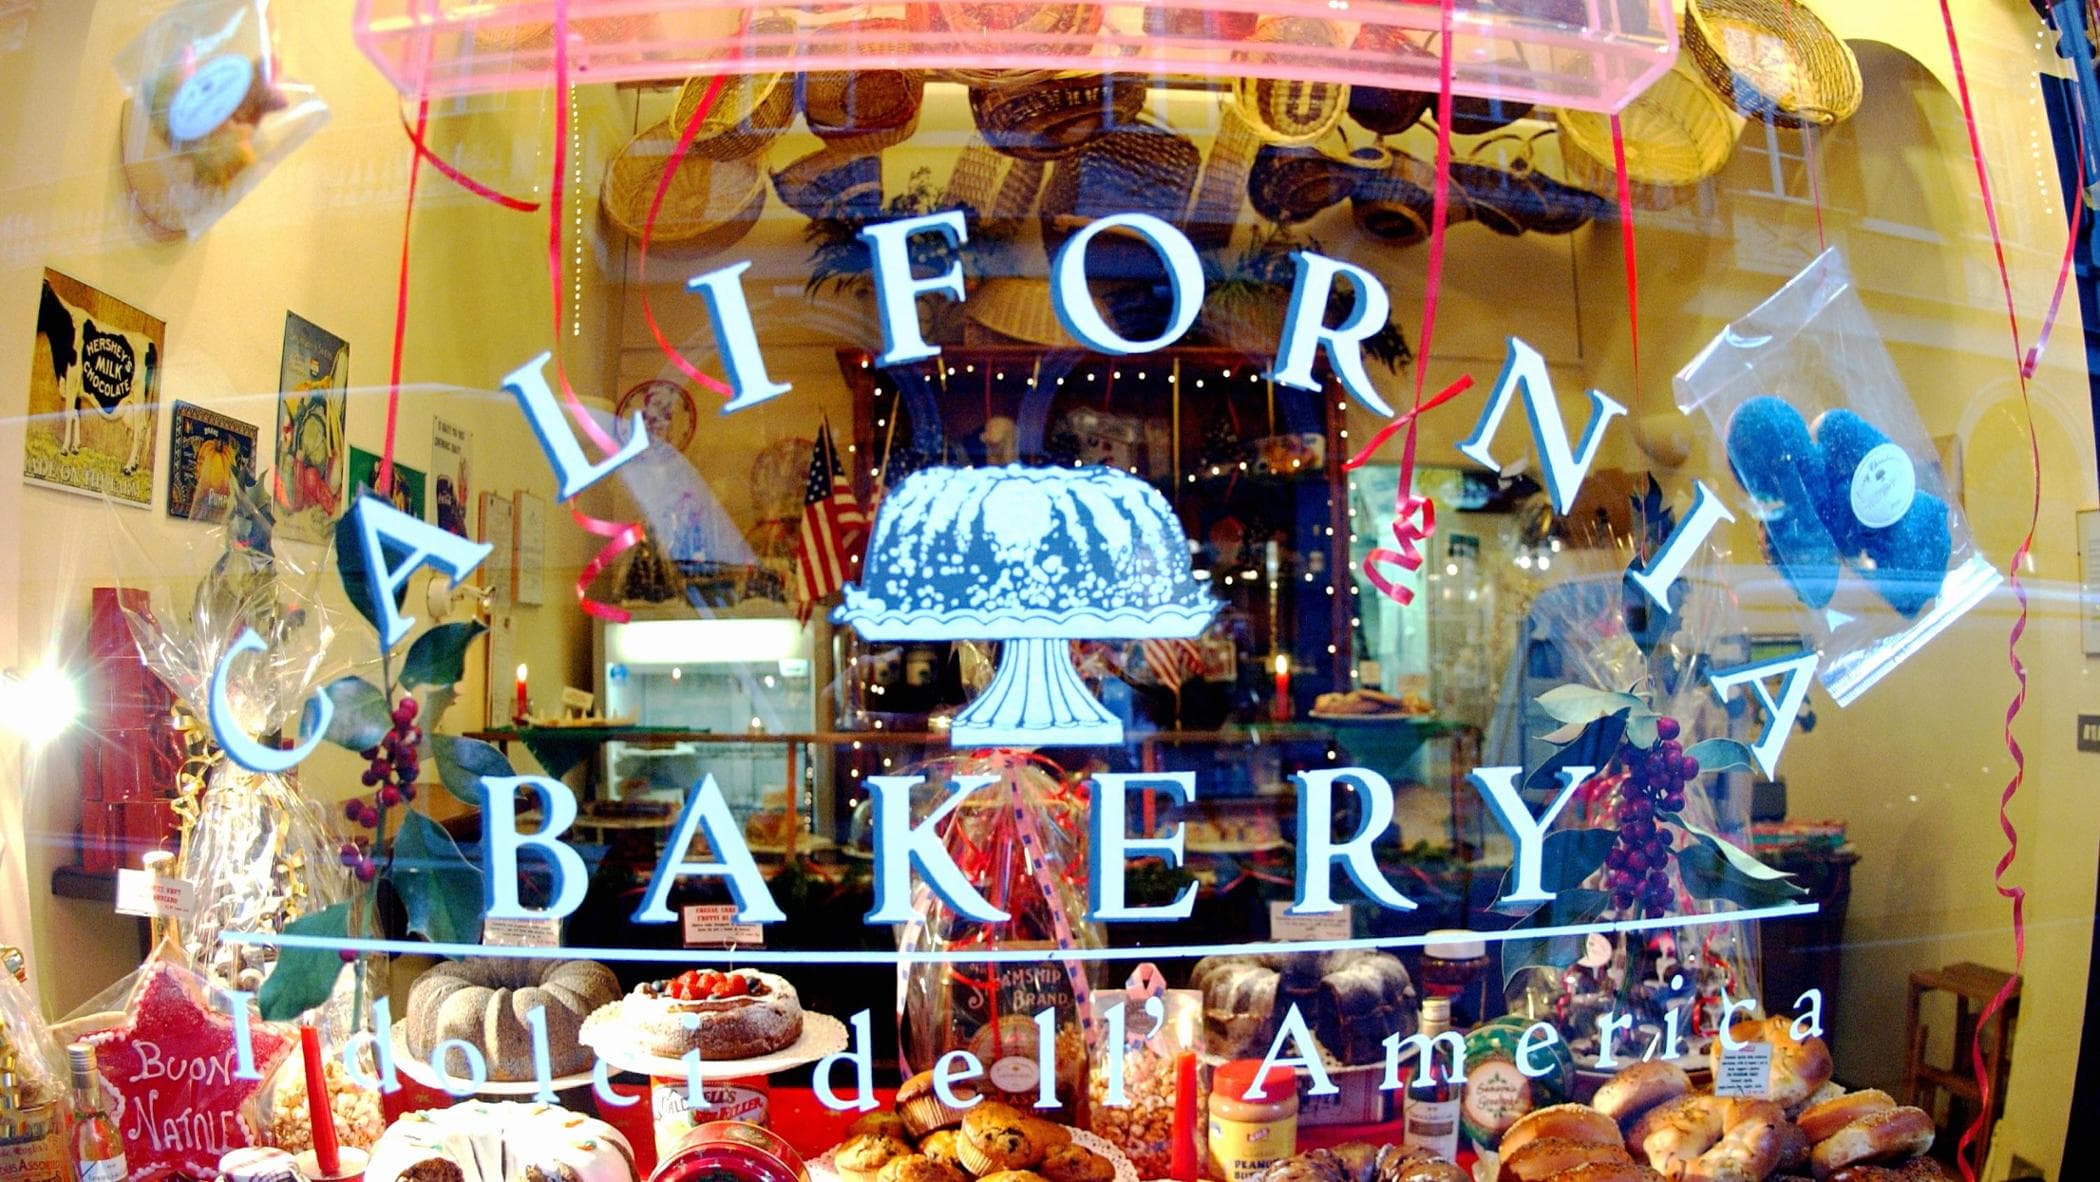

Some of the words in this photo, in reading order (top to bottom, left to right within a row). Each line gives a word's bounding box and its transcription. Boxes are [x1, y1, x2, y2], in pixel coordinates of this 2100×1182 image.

[87, 337, 133, 373] HERSHEY'S
[95, 356, 122, 380] MILK
[83, 361, 130, 397] CHOCOLATE
[209, 210, 1819, 782] CALIFORNIA
[479, 766, 1595, 925] BAKERY
[1013, 990, 1069, 1011] BRAND
[231, 990, 265, 1080] I
[343, 997, 711, 1108] dolci
